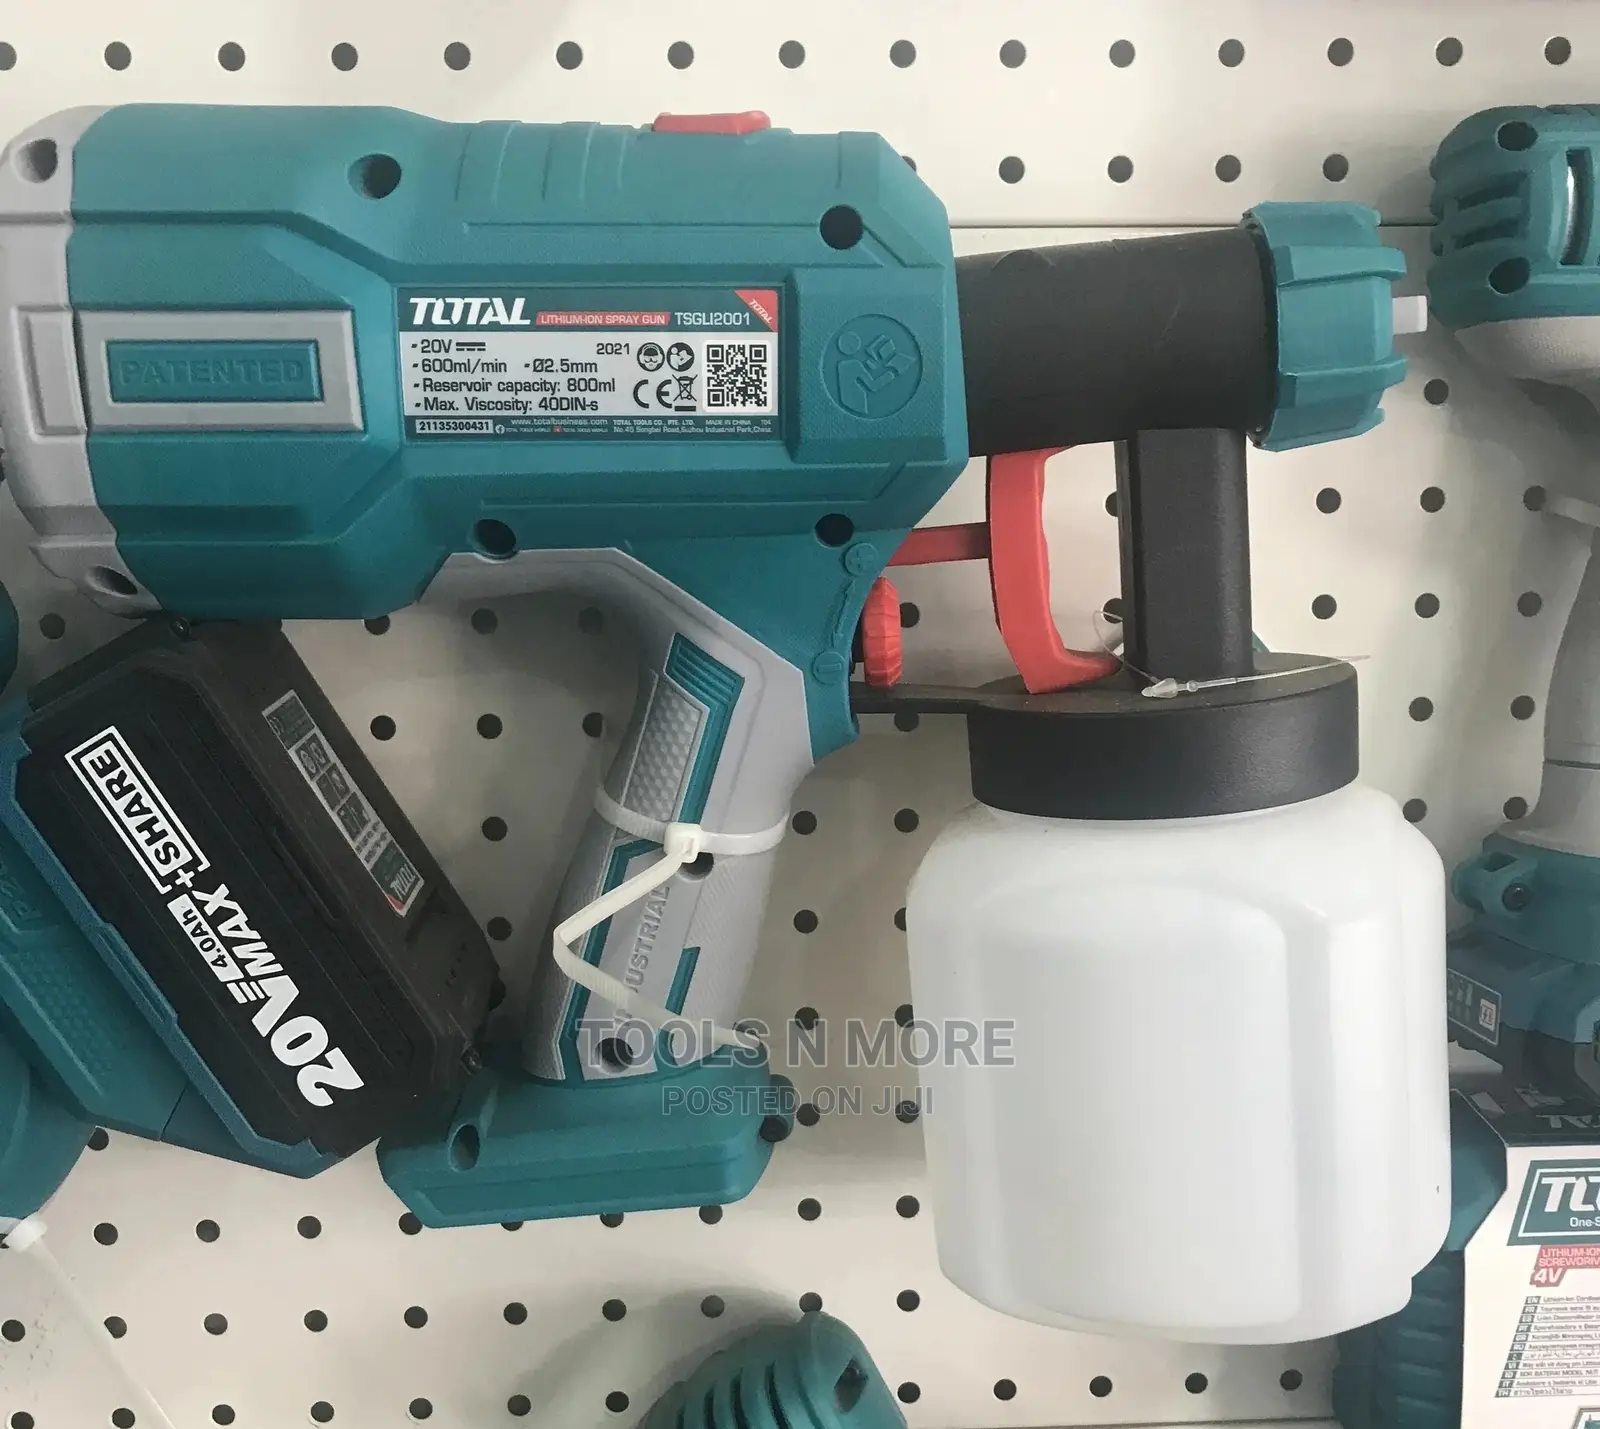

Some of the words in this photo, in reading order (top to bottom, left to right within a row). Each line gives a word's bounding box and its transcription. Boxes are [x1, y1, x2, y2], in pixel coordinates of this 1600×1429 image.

[409, 297, 531, 325] TOTAL
[541, 315, 602, 324] LITHIUM-ION
[606, 315, 639, 324] SPRAY
[642, 315, 665, 324] GUN
[749, 299, 773, 325] TOTAL
[596, 343, 630, 355] 2021
[118, 360, 304, 385] PATENTED
[422, 358, 507, 374] 600ml/min
[423, 377, 492, 392] Reservoir
[497, 378, 560, 395] capacity:
[567, 378, 616, 392] 800ml
[424, 397, 459, 411] Max.
[464, 396, 532, 414] Viscosity:
[419, 421, 489, 431] 21135300431
[182, 905, 228, 969] 4.0Ah
[192, 883, 284, 976] MAX
[1534, 1267, 1564, 1284] 4V
